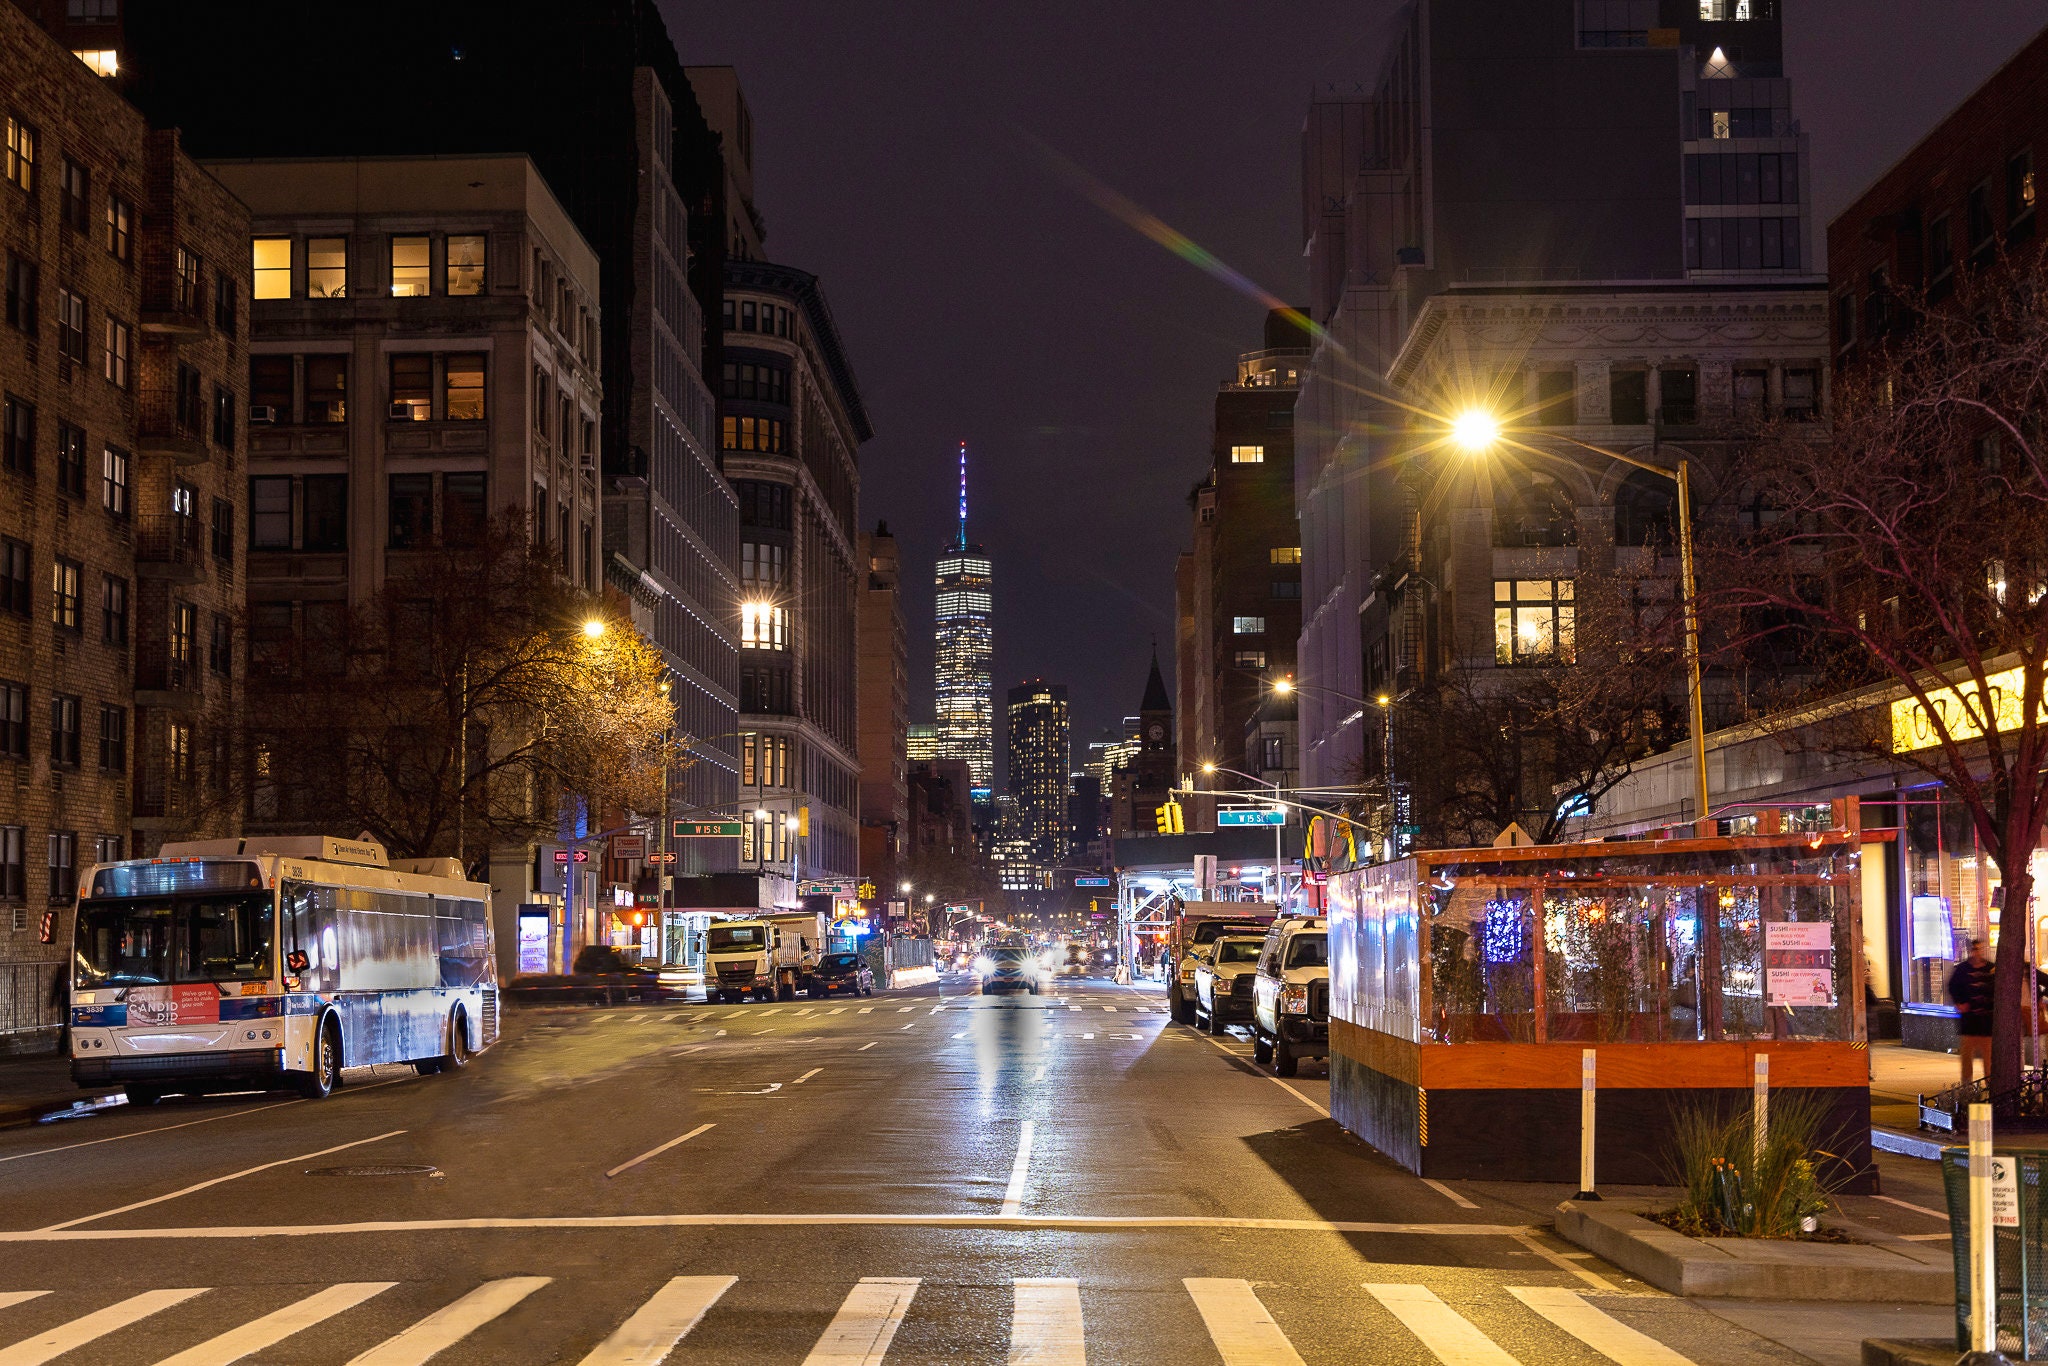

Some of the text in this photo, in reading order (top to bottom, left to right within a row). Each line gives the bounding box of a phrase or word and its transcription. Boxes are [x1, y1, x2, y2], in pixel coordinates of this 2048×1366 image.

[292, 866, 302, 877] 3839
[129, 993, 156, 1003] CAN
[129, 1002, 179, 1013] CANDID
[157, 1012, 179, 1022] DID
[2000, 1216, 2016, 1224] FINE
